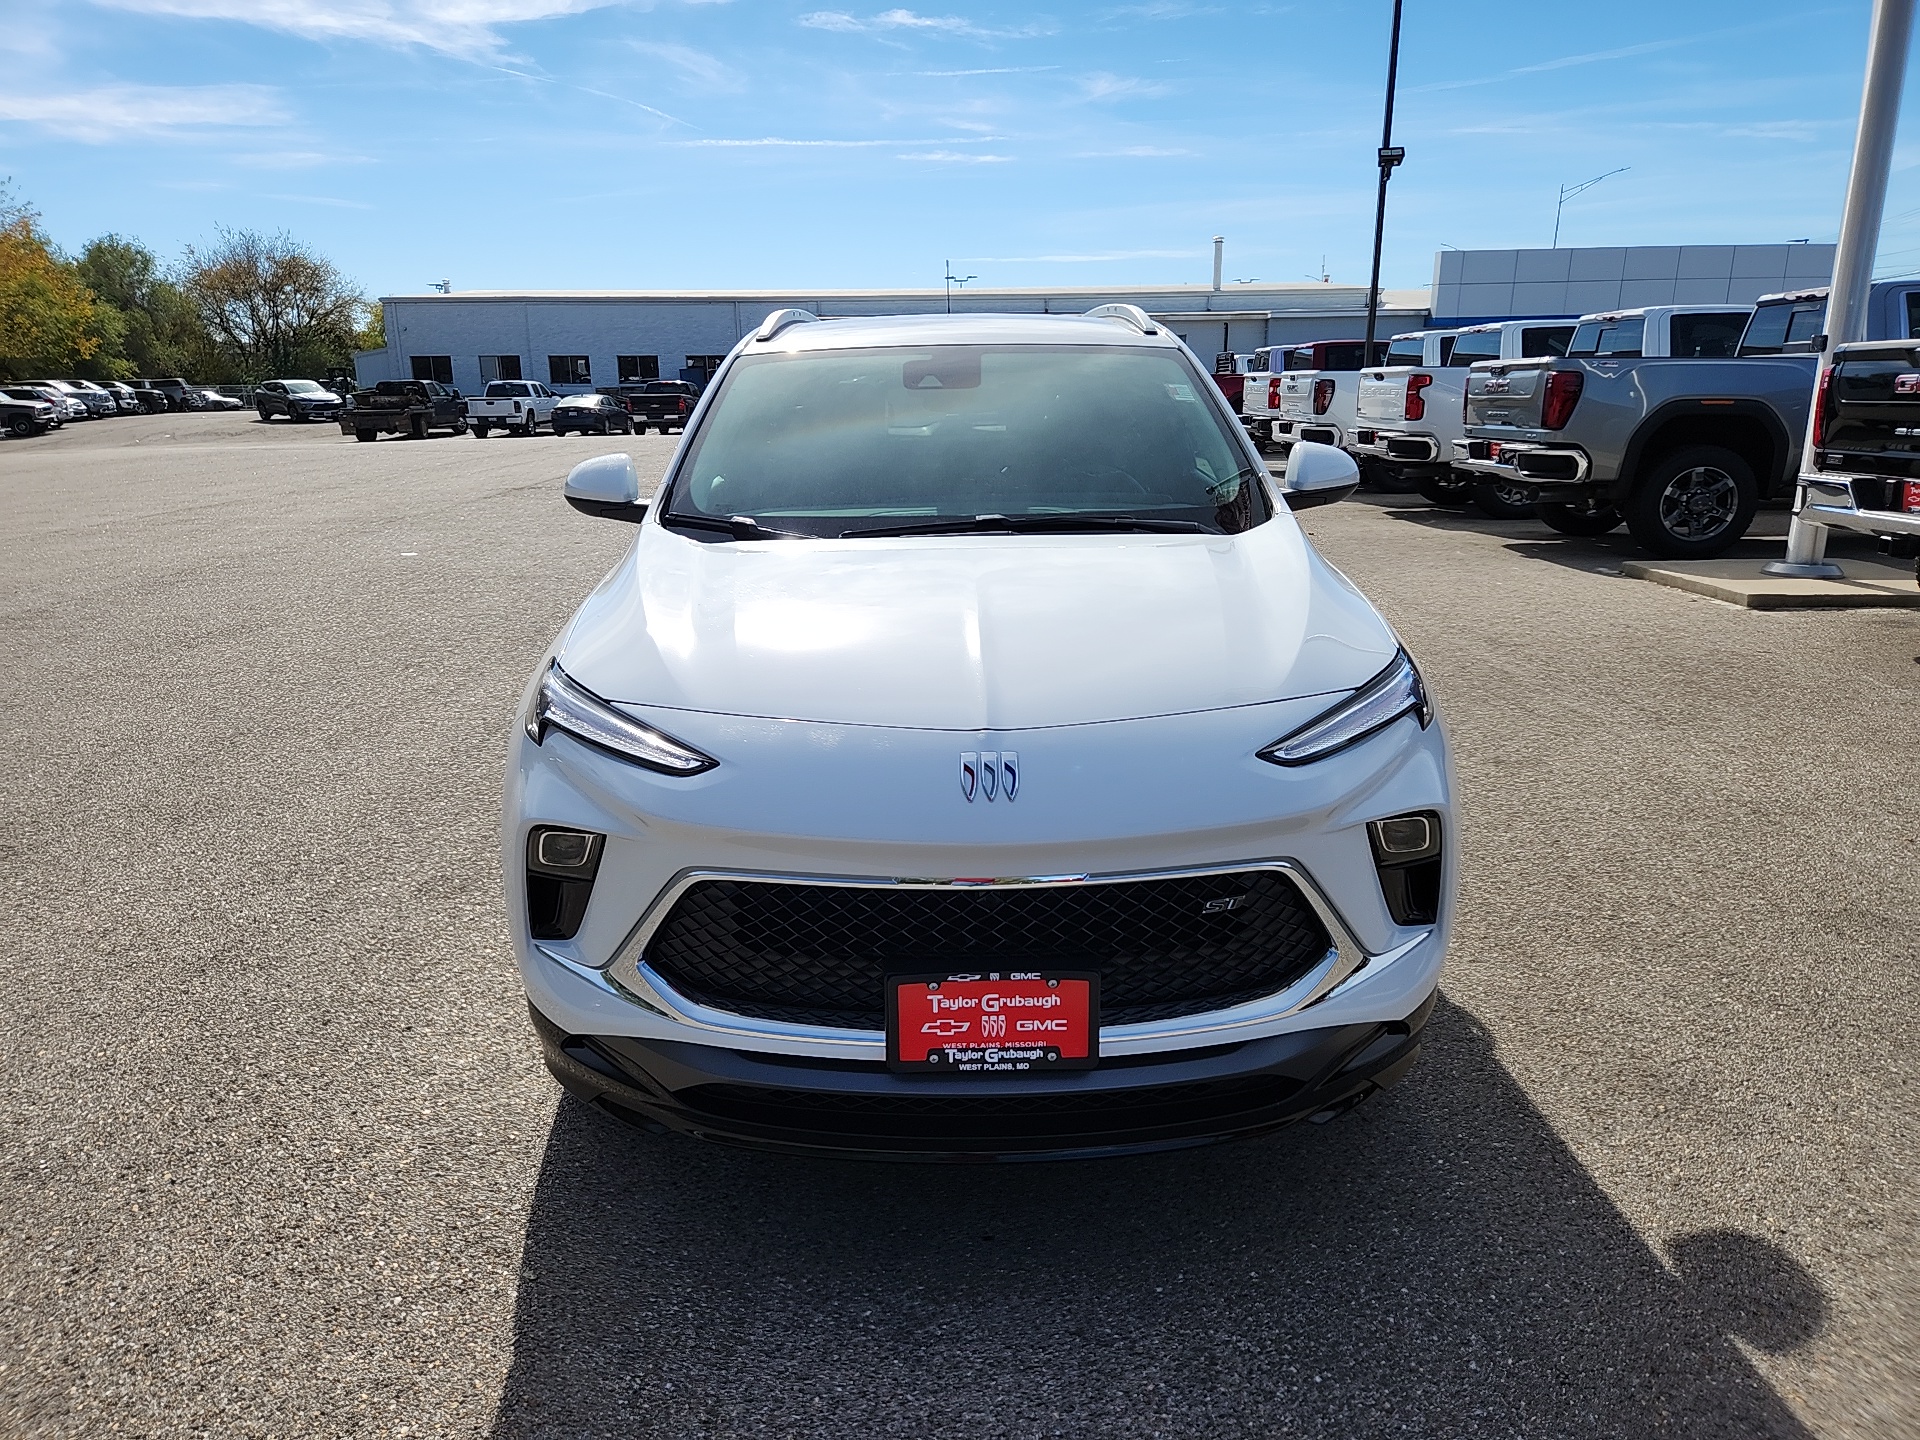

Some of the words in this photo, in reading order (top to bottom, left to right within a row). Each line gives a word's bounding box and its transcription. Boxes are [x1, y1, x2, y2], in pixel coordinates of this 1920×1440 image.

[1895, 374, 1920, 393] G
[1202, 894, 1246, 914] ST
[1010, 972, 1042, 981] GMC
[926, 995, 978, 1013] Taylor
[981, 994, 1060, 1012] Grubaugh
[1016, 1019, 1068, 1031] GMC
[944, 1049, 983, 1063] Taylor
[984, 1049, 1043, 1062] Grubaugh
[958, 1063, 982, 1071] WEST
